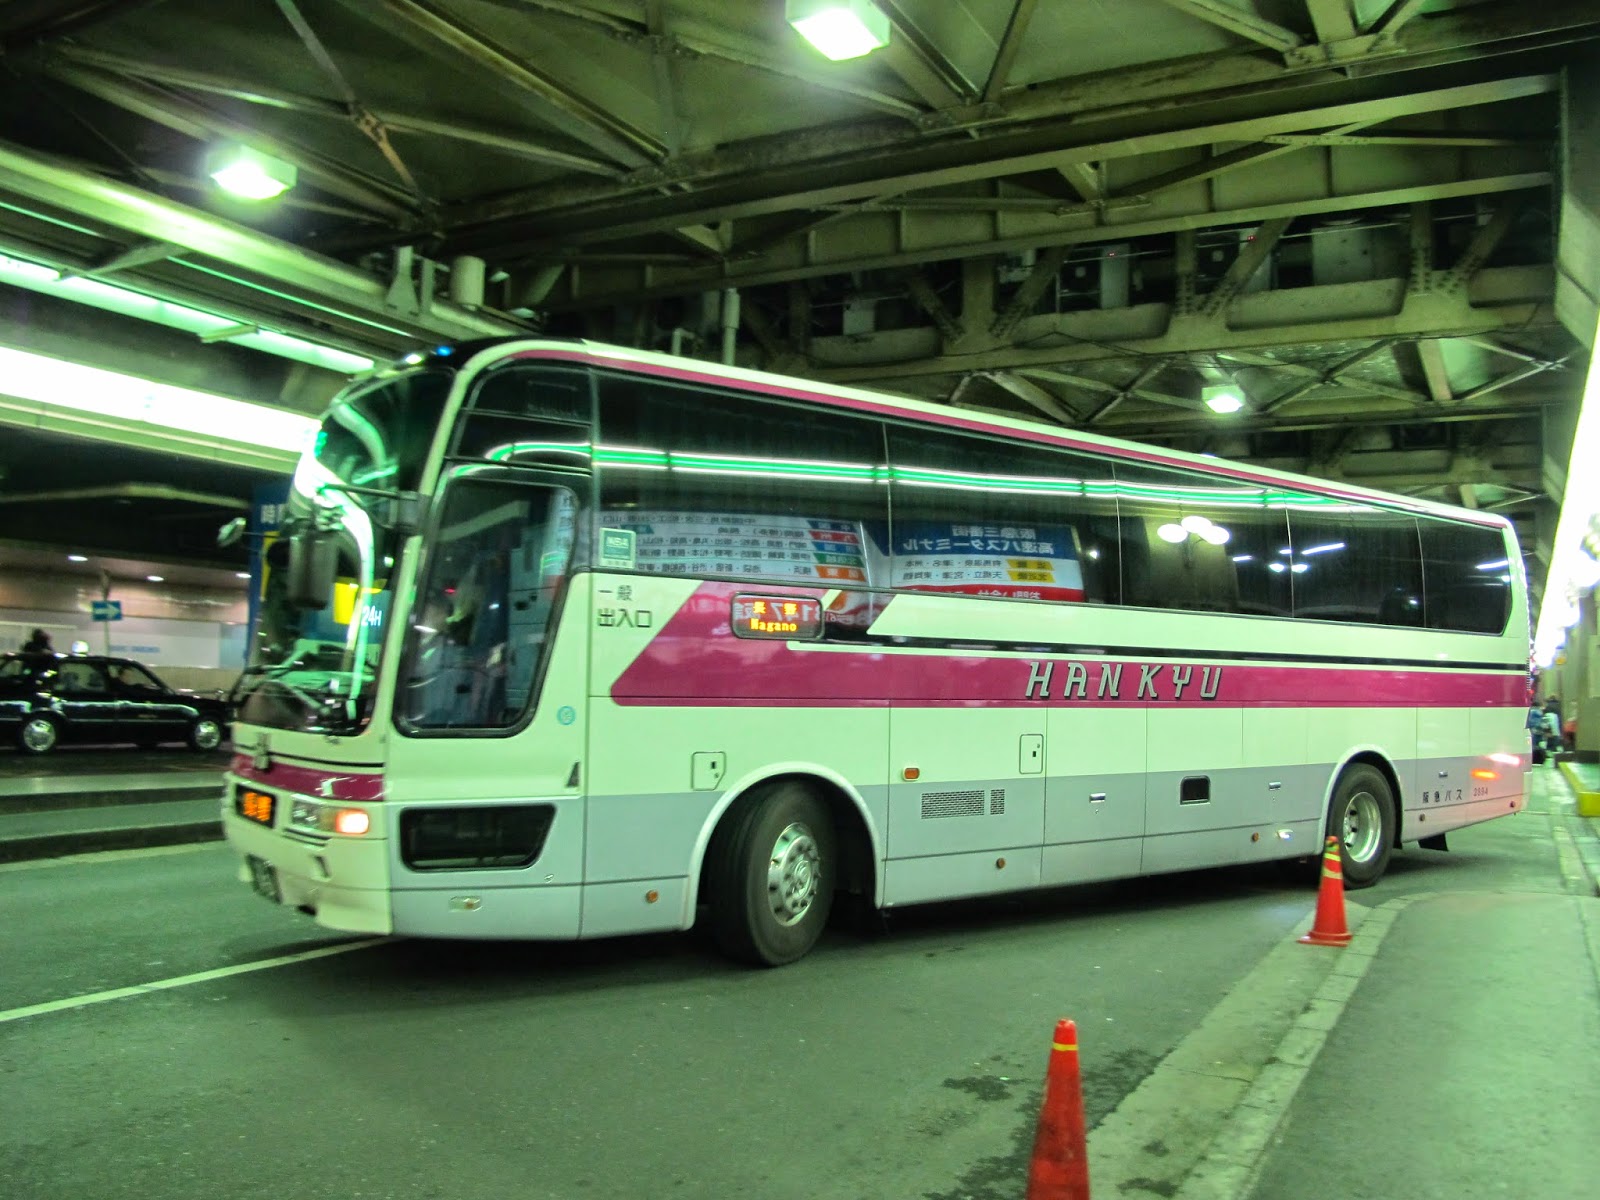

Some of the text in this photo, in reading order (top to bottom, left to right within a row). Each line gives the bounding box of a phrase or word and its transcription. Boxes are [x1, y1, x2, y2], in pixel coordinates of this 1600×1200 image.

[598, 584, 632, 601] 一般
[597, 608, 652, 628] 出入口
[750, 618, 798, 632] Nagano
[1025, 661, 1222, 698] HANKYU
